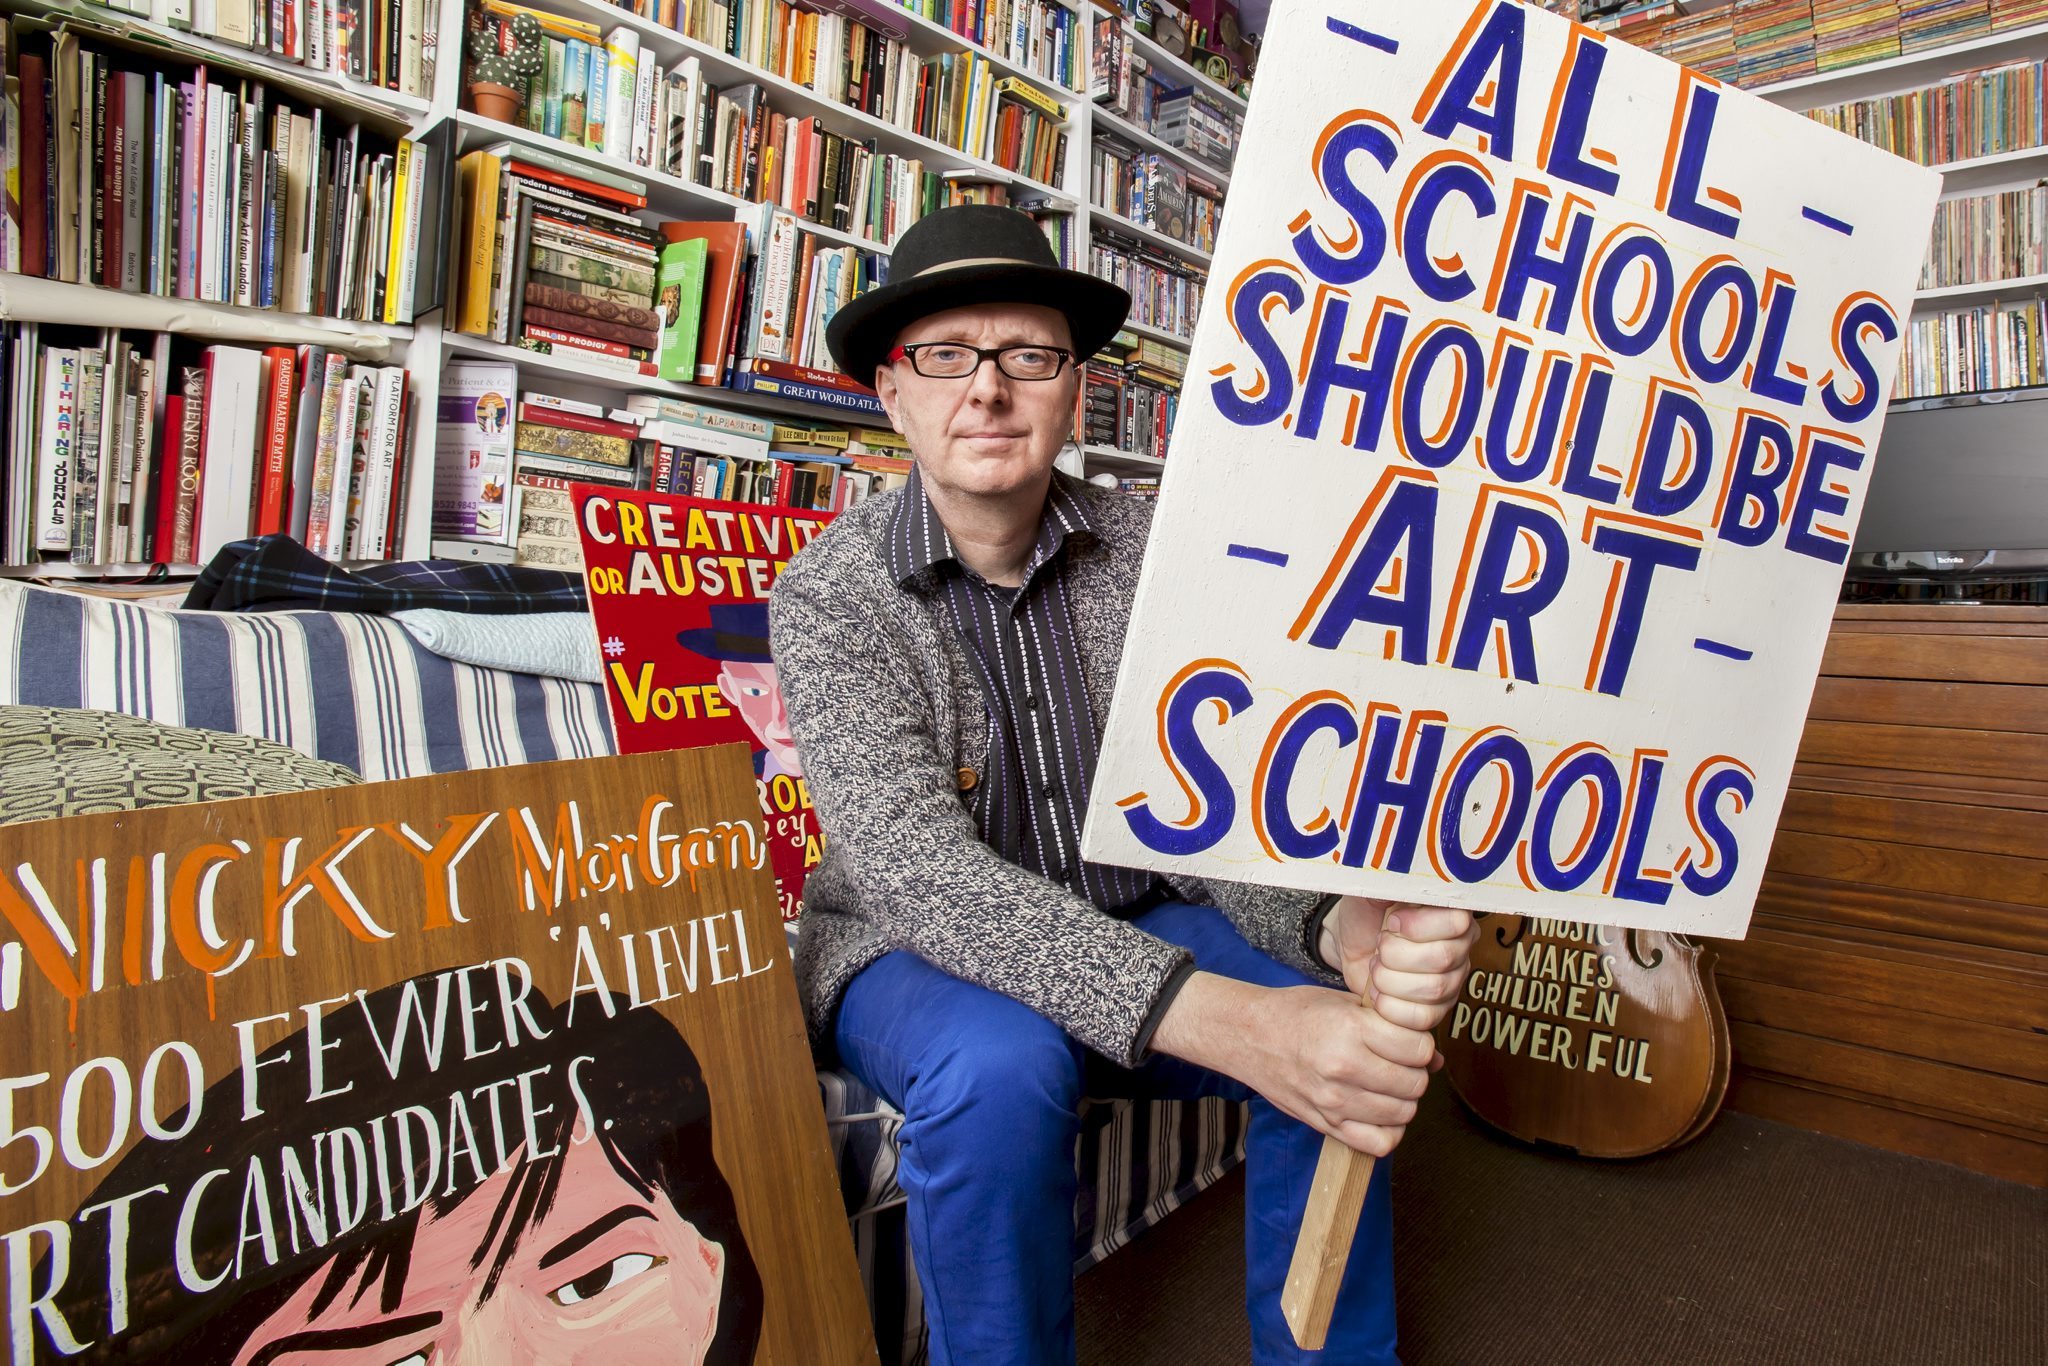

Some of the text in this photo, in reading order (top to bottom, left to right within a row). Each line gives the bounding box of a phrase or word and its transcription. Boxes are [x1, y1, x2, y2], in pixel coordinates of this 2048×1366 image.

[504, 27, 513, 57] JASPE
[1015, 19, 1026, 49] FINNEY
[576, 45, 586, 73] JASPER
[98, 80, 107, 105] Complete
[532, 76, 544, 110] FFORDE
[592, 50, 608, 121] JASPER FFORDE
[619, 69, 628, 97] FFORDE
[626, 72, 635, 99] JASPER
[98, 106, 106, 126] Crumb
[279, 111, 290, 130] THE
[1414, 0, 1741, 239] ALL
[97, 126, 105, 146] Comics
[114, 126, 124, 152] Dürer
[279, 133, 289, 151] NEW
[114, 153, 122, 164] in
[130, 151, 138, 165] New
[113, 165, 122, 197] Believe
[129, 175, 137, 195] Gallery
[548, 184, 574, 198] music
[1147, 168, 1158, 213] AMADEUS
[239, 121, 254, 296] Metropolis Rise New Art from London
[409, 158, 423, 251] Making Contemporary Sculpture
[560, 208, 588, 221] Brand
[475, 224, 487, 270] Arte povera
[128, 252, 136, 276] Batsford
[766, 243, 782, 307] Encyclopedia
[774, 229, 793, 327] Children's Illustrated
[1288, 110, 1898, 423] SCHOOLS
[530, 327, 608, 351] TABLOID PRODIGY
[762, 340, 778, 351] DK
[141, 369, 149, 378] 2
[279, 357, 291, 400] GAUGUIN:
[448, 377, 484, 387] Patient
[807, 371, 836, 384] Starter-Set
[783, 385, 817, 400] GREAT
[818, 390, 856, 406] WORLD
[857, 399, 886, 412] ATLAS
[1210, 259, 1866, 564] SHOULD BE
[133, 390, 149, 473] Painters on Painting
[276, 401, 288, 433] MAKER
[344, 405, 355, 441] BRITANNIA:
[383, 375, 401, 469] PLATFORM FOR ART
[51, 357, 74, 525] KEITH HARING JOURNALS
[180, 399, 200, 500] HENRY ROOT
[274, 433, 284, 444] OF
[783, 430, 792, 439] LEE
[793, 431, 808, 441] CHILD
[818, 433, 830, 442] NEVER
[111, 423, 121, 483] EGON SCHIELE
[272, 445, 284, 473] MYTH
[678, 451, 693, 481] LEE
[694, 475, 705, 497] ONE
[378, 500, 387, 530] Underground
[457, 500, 477, 510] 9843
[589, 550, 785, 599] OR AUSTE
[1936, 555, 1964, 564] Technika
[1287, 466, 1704, 698] ART
[609, 660, 731, 725] VOTE
[1116, 658, 1757, 905] SCHOOLS
[0, 811, 499, 1010] NICKY
[1530, 917, 1615, 948] MUSIC
[1512, 941, 1617, 989] MAKES
[1468, 970, 1620, 1027] CHILDREN
[234, 956, 552, 1122] FEWER
[619, 909, 775, 1013] LEVEL
[174, 1055, 614, 1294] CANDIDATES.
